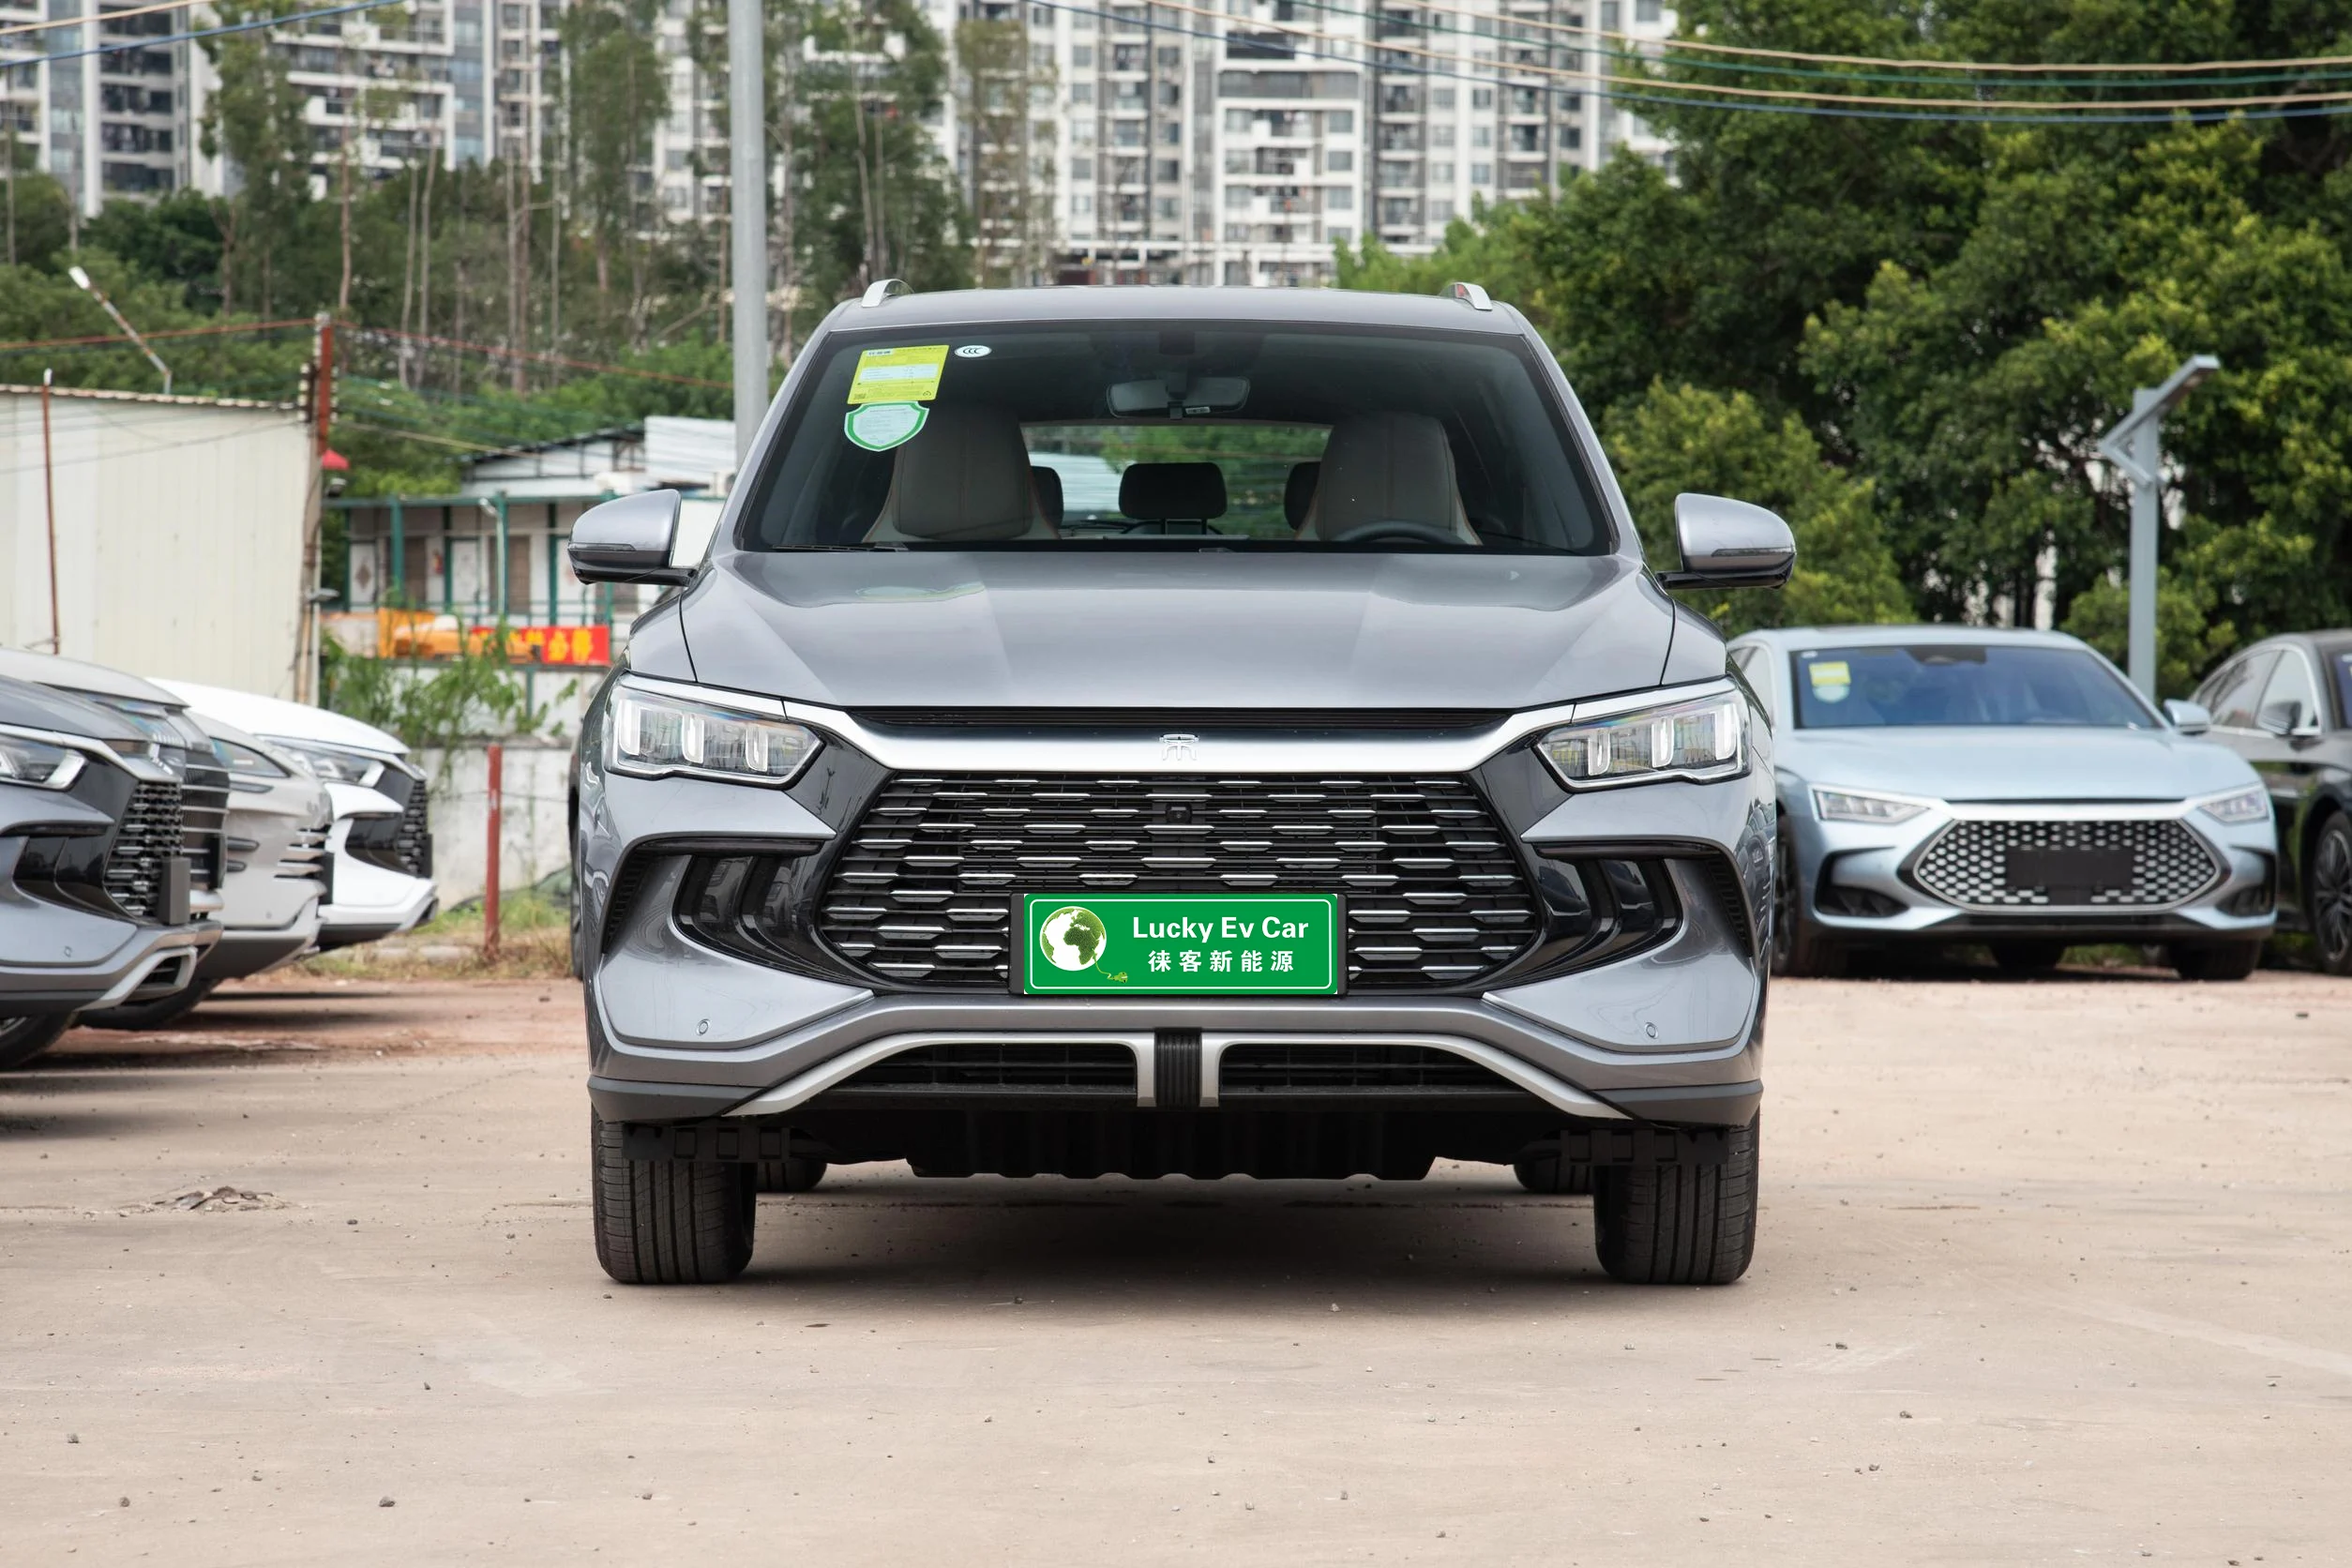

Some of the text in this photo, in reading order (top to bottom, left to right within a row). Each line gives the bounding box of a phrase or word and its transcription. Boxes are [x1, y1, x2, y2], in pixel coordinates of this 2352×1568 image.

[1133, 915, 1309, 943] Lucky Ev Car
[1147, 949, 1294, 972] 徕客新能源
